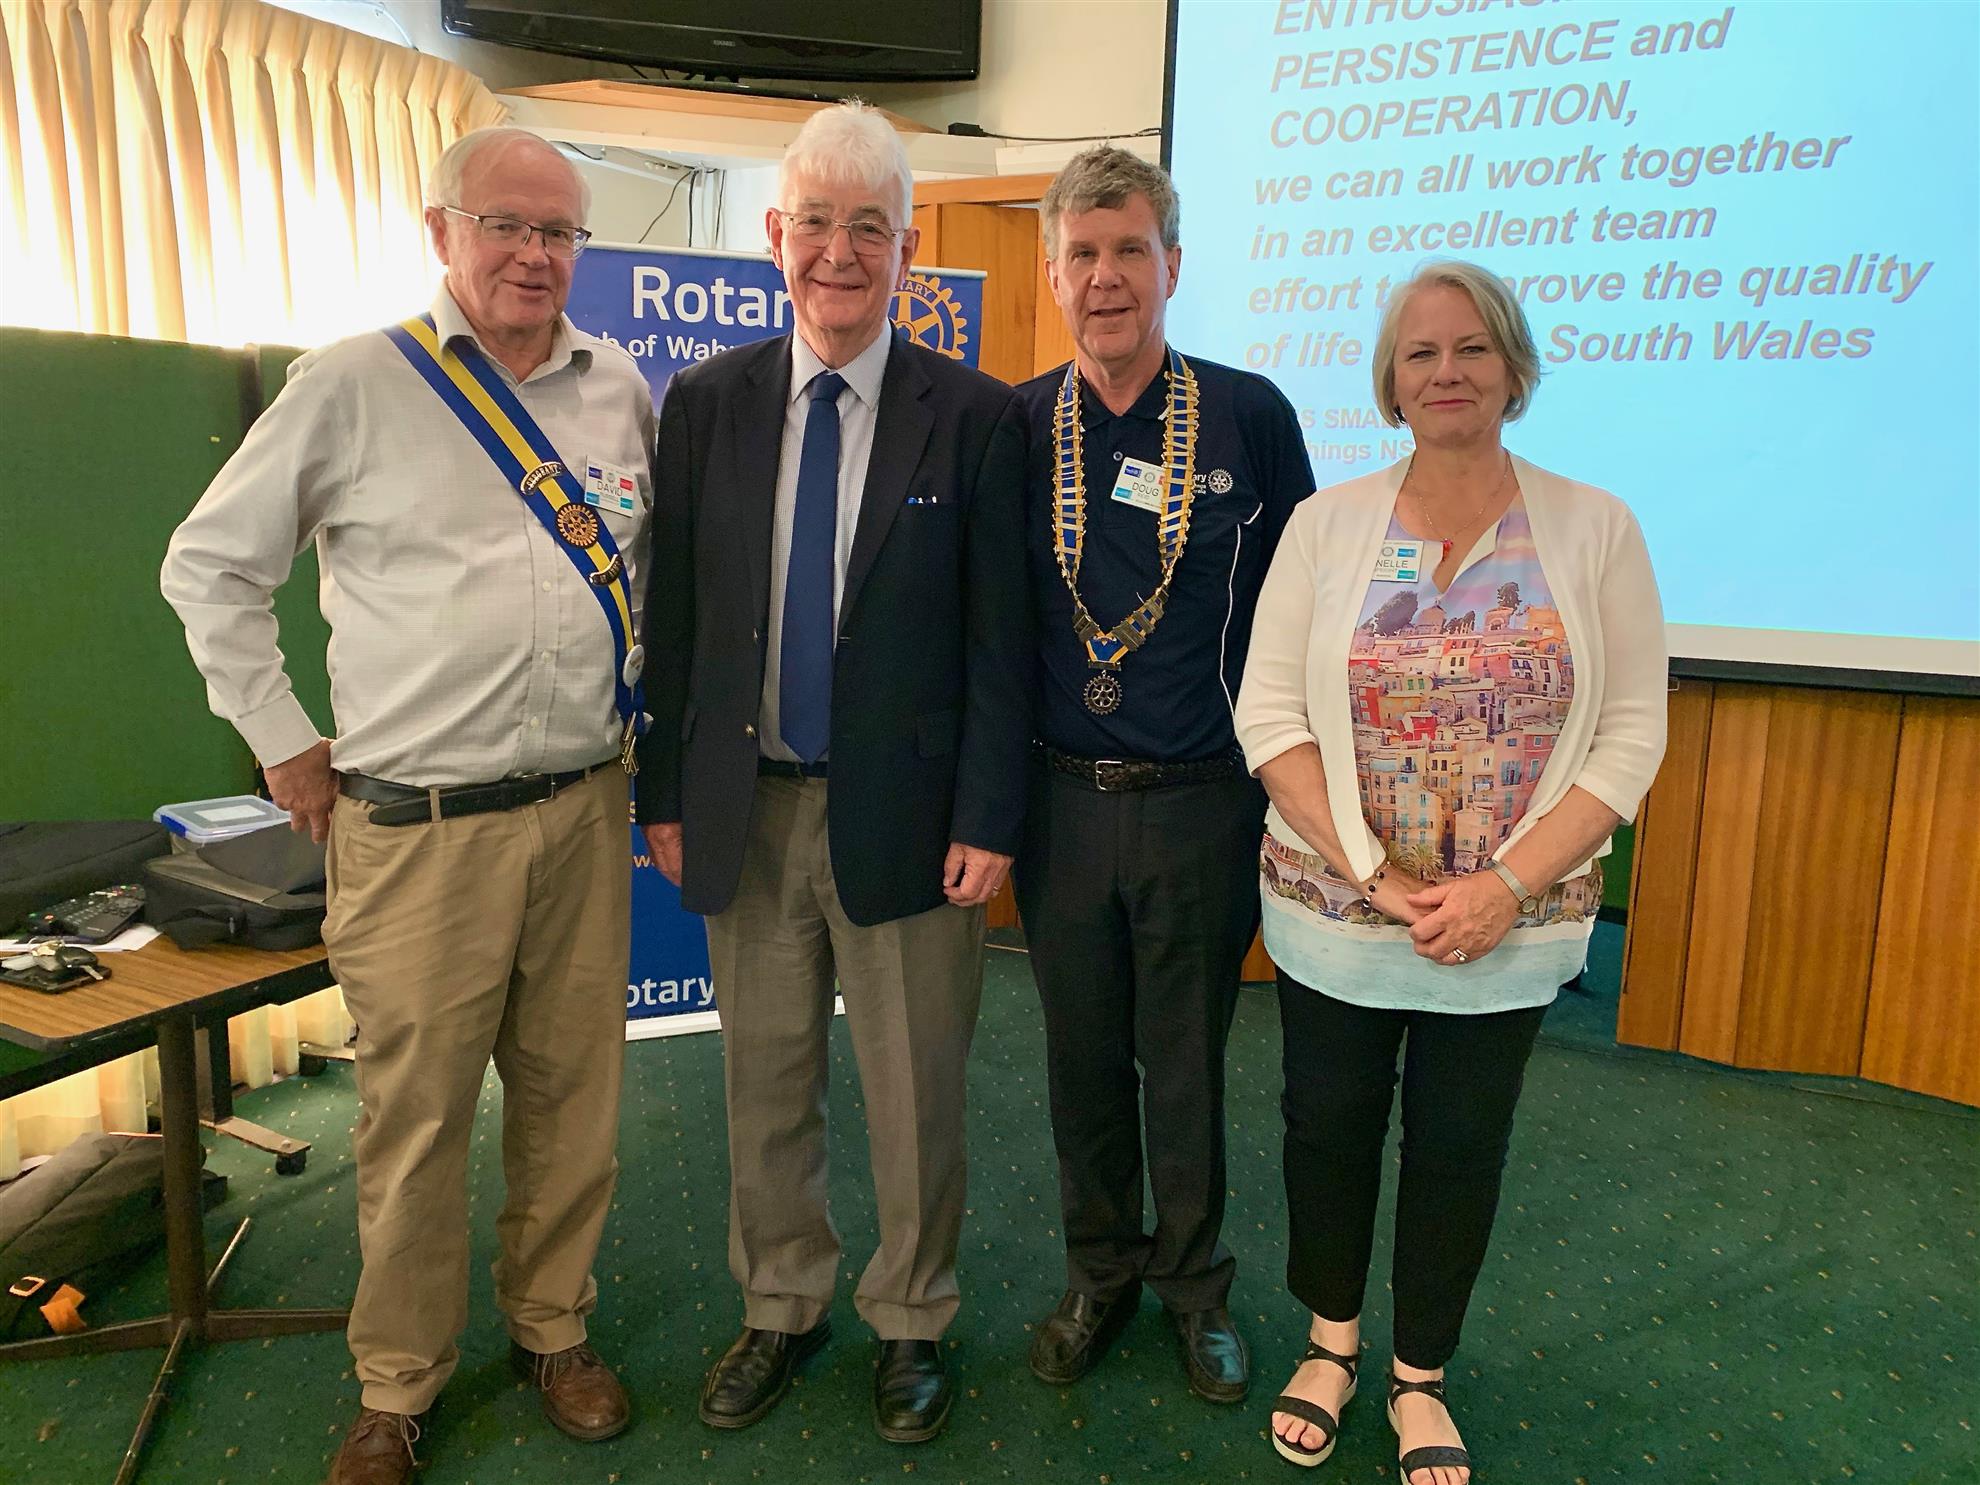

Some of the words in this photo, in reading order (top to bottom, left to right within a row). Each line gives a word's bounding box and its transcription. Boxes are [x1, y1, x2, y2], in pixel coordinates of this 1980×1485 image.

[1270, 18, 1620, 93] PERSISTENCE
[1630, 6, 1736, 56] and
[1270, 79, 1637, 148] COOPERATION,
[1255, 175, 1312, 205] we
[1325, 167, 1404, 200] can
[1417, 153, 1474, 194] all
[1487, 144, 1607, 189] work
[1620, 131, 1852, 188] together
[1250, 225, 1290, 260] in
[1301, 226, 1354, 256] an
[1368, 207, 1579, 253] excellent
[1591, 205, 1718, 242] team
[632, 265, 792, 329] Rotar
[900, 280, 932, 298] ARY
[1248, 276, 1363, 314] effort
[1375, 274, 1392, 309] t
[1502, 271, 1626, 304] rove
[1642, 260, 1723, 300] the
[1738, 253, 1935, 307] quality
[628, 334, 658, 358] of
[1245, 333, 1292, 368] of
[1296, 331, 1362, 367] life
[1545, 322, 1693, 363] South
[1713, 319, 1875, 360] Wales
[1308, 440, 1372, 464] hings
[1380, 440, 1415, 460] NS
[597, 481, 622, 496] DAVID
[1131, 482, 1160, 497] DOUG
[1375, 560, 1409, 568] NELLE
[626, 977, 714, 1008] otary
